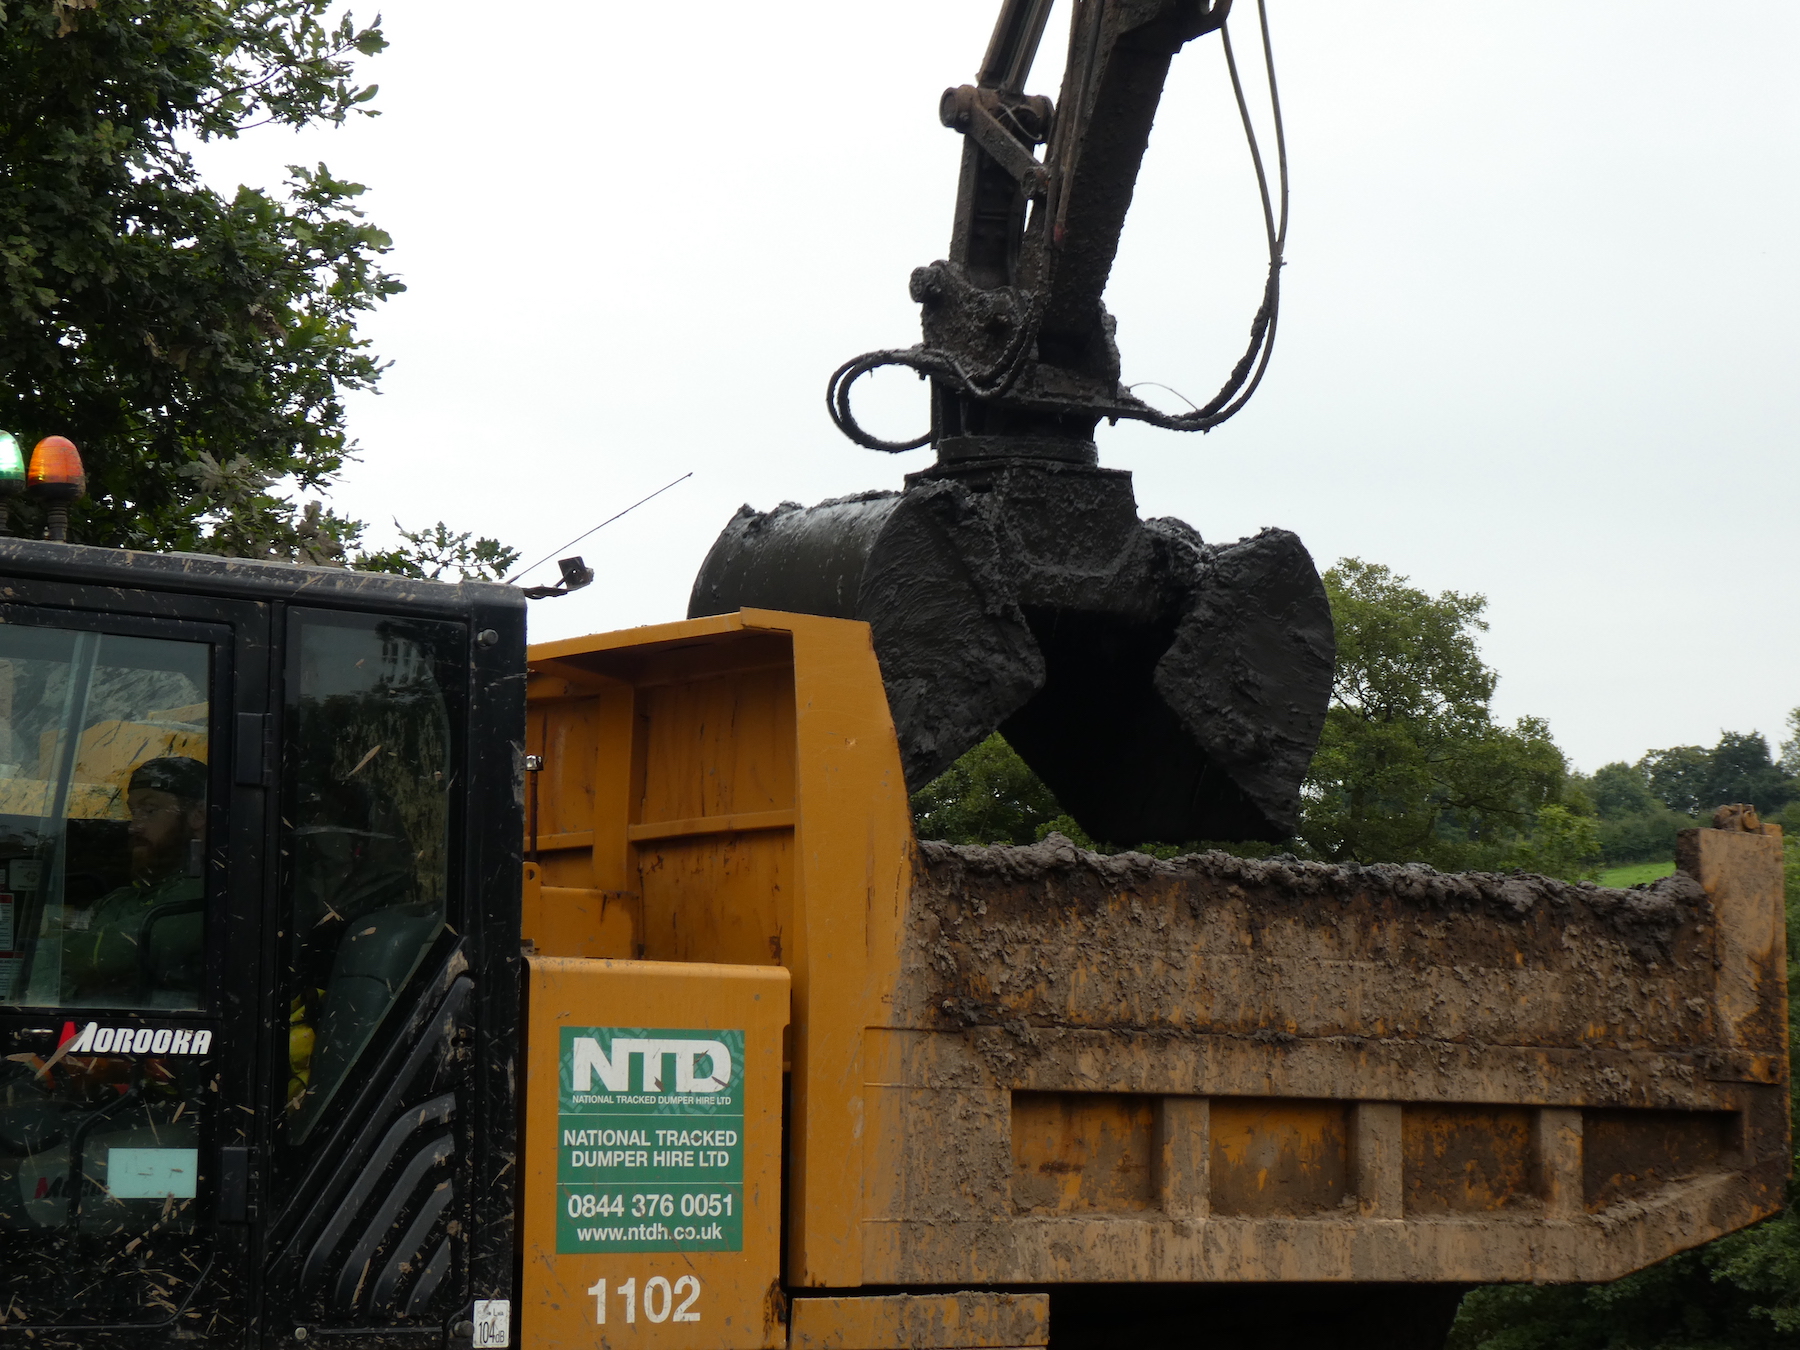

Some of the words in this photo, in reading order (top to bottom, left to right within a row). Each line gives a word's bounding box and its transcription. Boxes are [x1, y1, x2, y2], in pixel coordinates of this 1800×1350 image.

[56, 1021, 213, 1055] MOROOKA
[572, 1037, 732, 1093] NTD
[572, 1094, 615, 1104] NATIONAL
[616, 1095, 656, 1104] TRACKED
[657, 1095, 694, 1105] DUMPER
[695, 1096, 715, 1105] HIRE
[716, 1096, 732, 1105] LTD
[563, 1129, 651, 1146] NATIONAL
[655, 1129, 738, 1147] TRACKED
[571, 1150, 648, 1167] DUMPER
[653, 1150, 695, 1167] HIRE
[699, 1150, 730, 1167] LTD
[567, 1194, 625, 1218] 0844
[631, 1193, 674, 1217] 376
[680, 1193, 733, 1217] 0051
[576, 1222, 723, 1241] www.ntdh.co.uk
[587, 1275, 701, 1325] 1102
